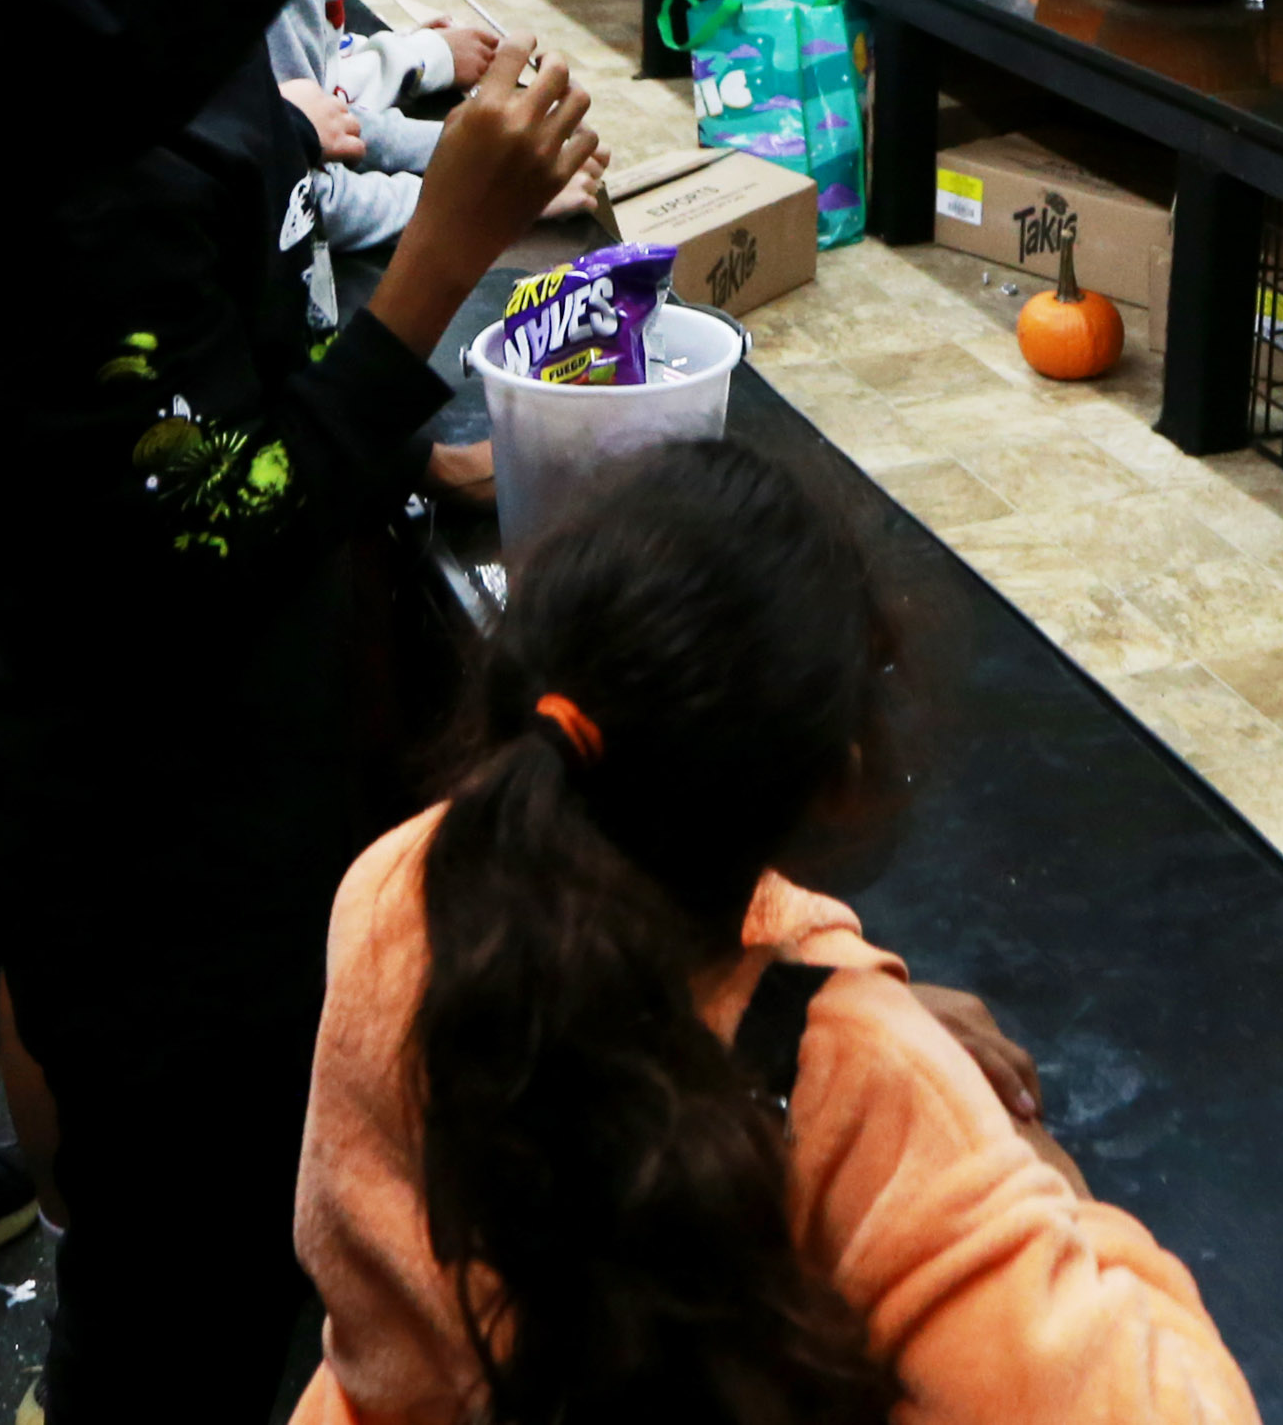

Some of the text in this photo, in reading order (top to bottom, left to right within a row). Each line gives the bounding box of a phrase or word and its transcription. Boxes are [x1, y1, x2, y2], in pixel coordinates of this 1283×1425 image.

[506, 264, 574, 318] akis
[705, 235, 758, 308] Takis
[549, 356, 587, 381] FUEGO
